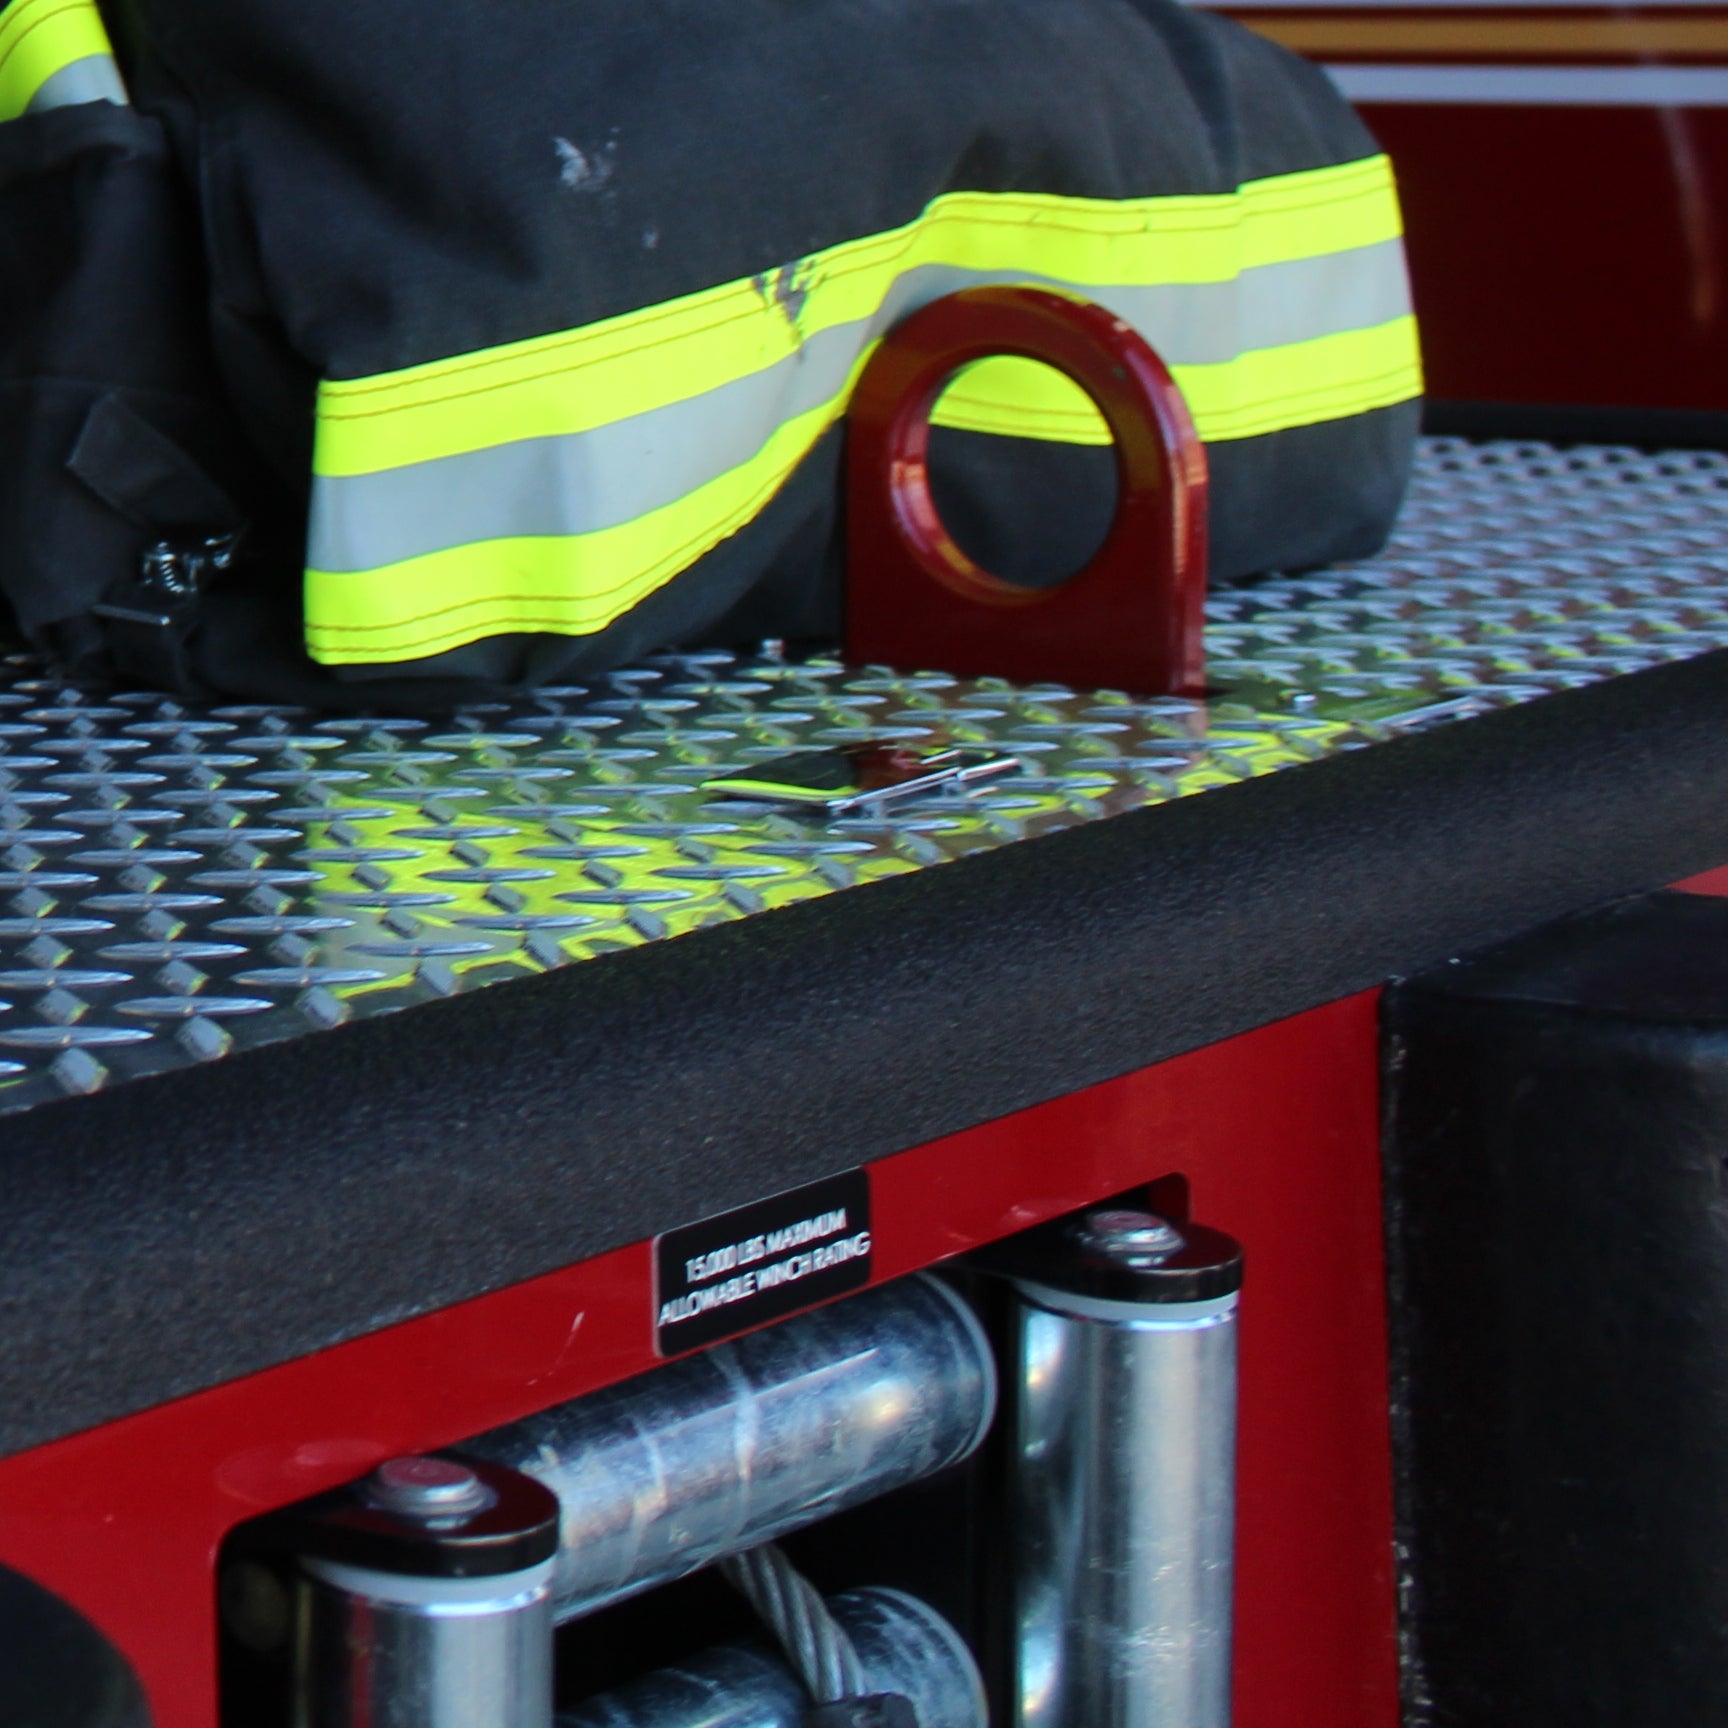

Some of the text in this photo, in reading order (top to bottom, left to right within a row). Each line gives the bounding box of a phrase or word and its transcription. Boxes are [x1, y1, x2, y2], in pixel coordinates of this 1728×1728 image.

[767, 1208, 846, 1254] MAXIMUM
[657, 1231, 872, 1327] ALLOWABLE WINCH RATING
